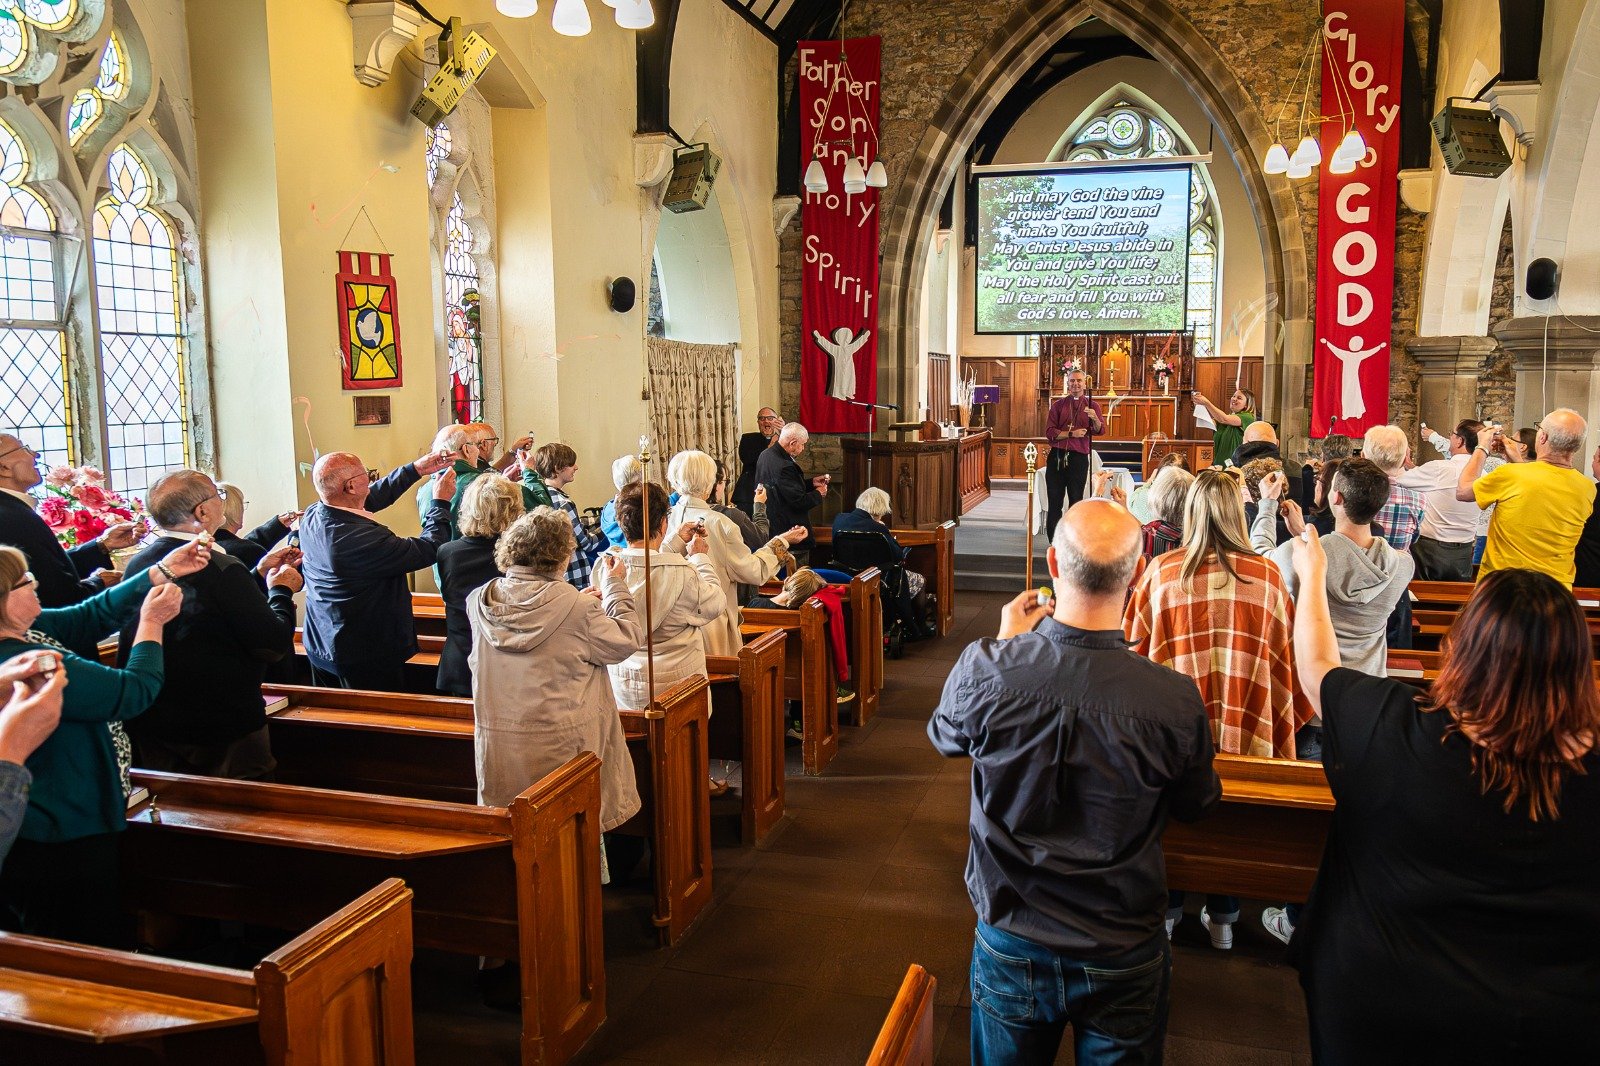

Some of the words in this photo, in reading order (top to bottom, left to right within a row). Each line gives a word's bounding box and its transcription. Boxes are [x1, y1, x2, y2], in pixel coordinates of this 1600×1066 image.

[800, 48, 877, 101] Father
[1324, 11, 1400, 133] Glory
[810, 97, 867, 134] Son
[813, 141, 868, 171] and
[1005, 190, 1034, 203] And
[1036, 191, 1068, 205] may
[1070, 188, 1101, 202] God
[1103, 187, 1128, 201] the
[1131, 186, 1164, 200] vine
[1006, 208, 1060, 224] grower
[1062, 205, 1098, 219] tend
[1100, 205, 1129, 218] You
[1130, 203, 1161, 218] and
[1017, 224, 1057, 237] make
[1061, 224, 1089, 236] You
[1091, 221, 1149, 237] fruitful;
[992, 242, 1022, 256] May
[1025, 241, 1068, 254] Christ
[1069, 240, 1112, 253] Jesus
[1114, 238, 1156, 252] abide
[1157, 238, 1173, 251] in
[1332, 182, 1378, 327] GOD
[1006, 259, 1033, 271] You
[1034, 257, 1063, 271] and
[1063, 257, 1096, 273] give
[1100, 257, 1127, 269] You
[1129, 256, 1160, 271] life;
[805, 234, 873, 318] Spirit
[984, 275, 1014, 290] May
[1016, 275, 1040, 287] the
[1042, 274, 1077, 290] Holy
[1078, 273, 1119, 289] Spirit
[1121, 273, 1153, 286] cast
[1154, 271, 1180, 285] out
[996, 291, 1016, 304] all
[1017, 291, 1047, 304] fear
[1048, 290, 1078, 304] and
[1078, 290, 1099, 303] fill
[1102, 290, 1129, 303] You
[1132, 289, 1165, 302] with
[1017, 307, 1056, 320] God's
[1059, 307, 1092, 320] love.
[1096, 307, 1141, 319] Amen.
